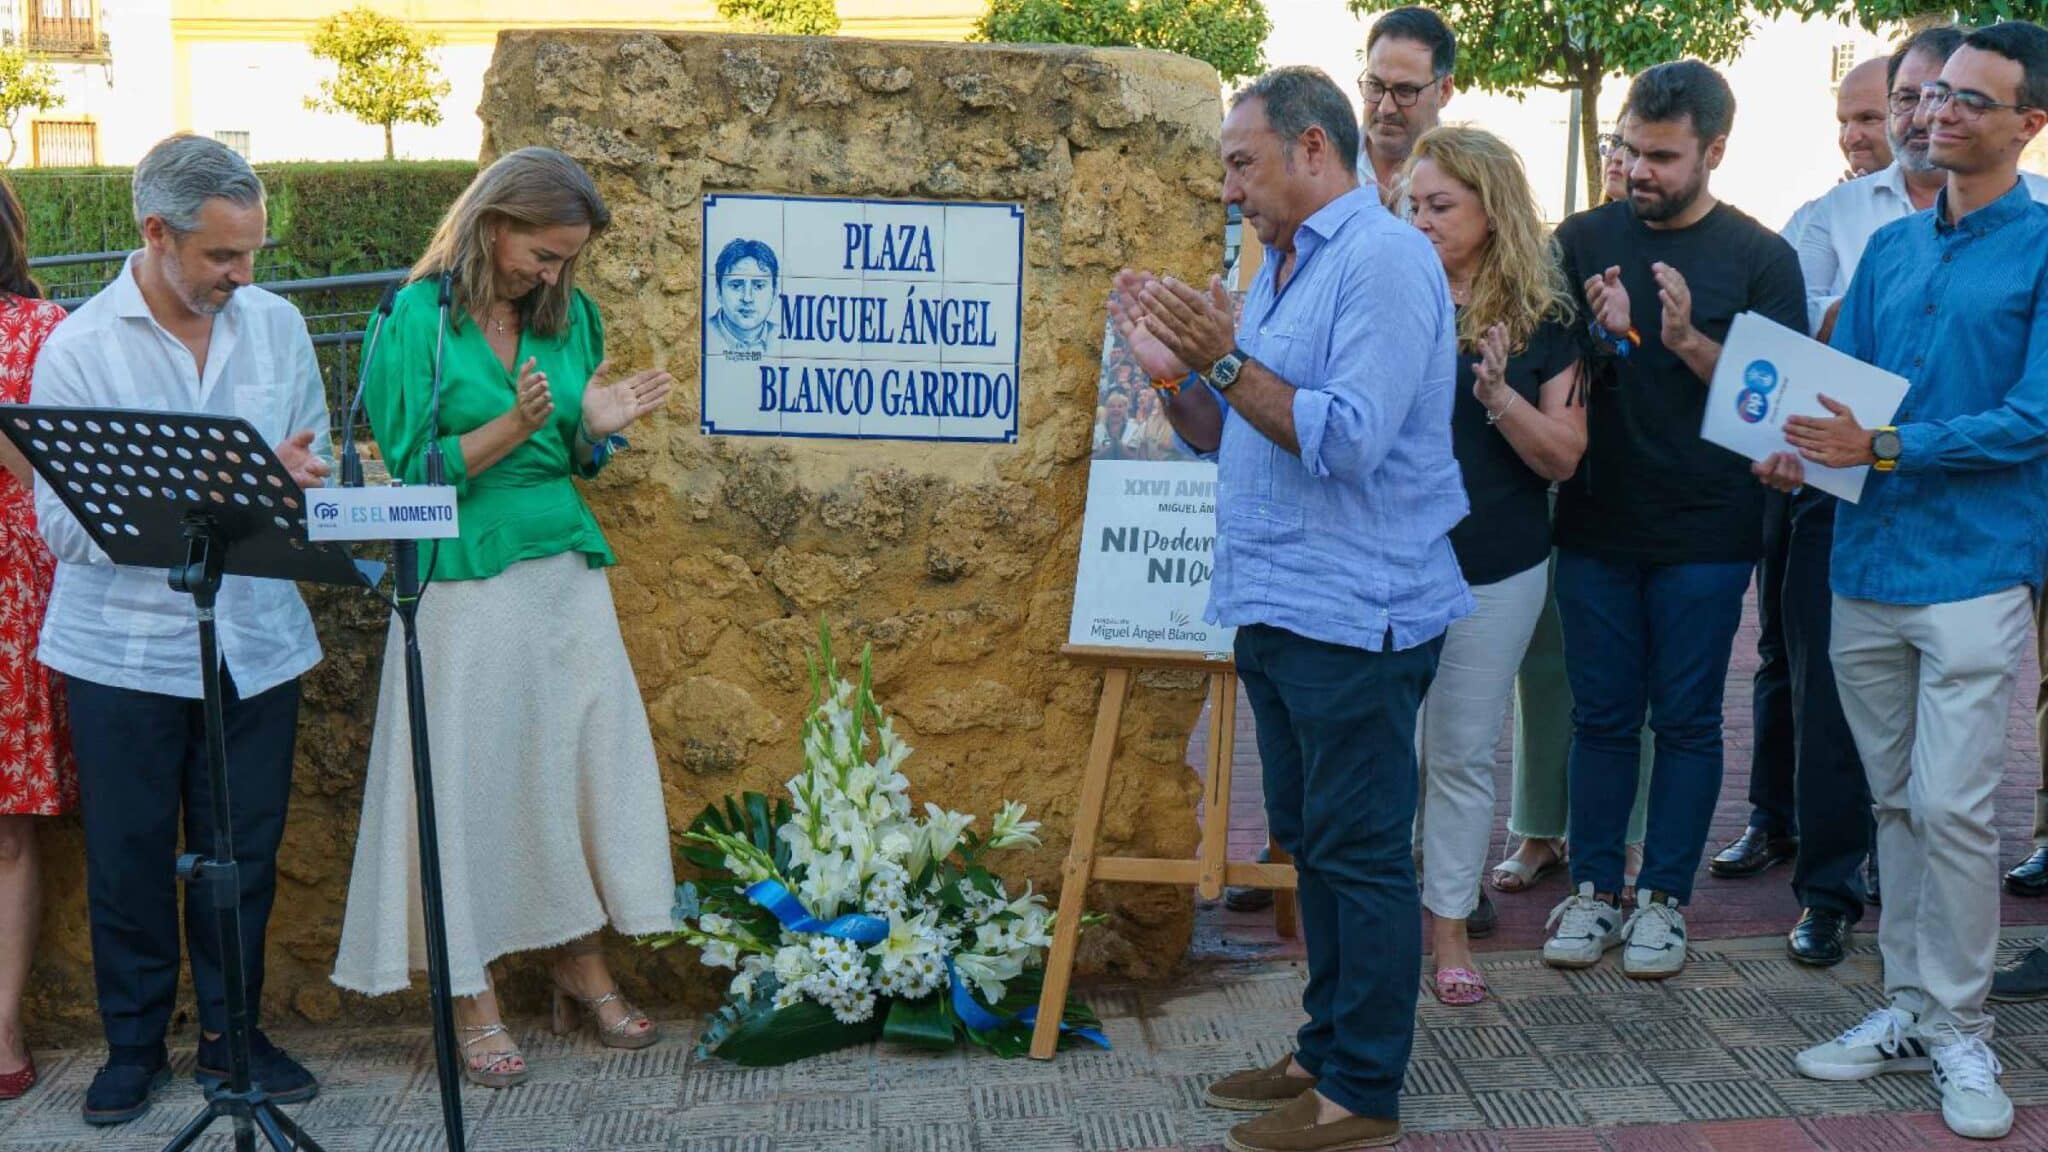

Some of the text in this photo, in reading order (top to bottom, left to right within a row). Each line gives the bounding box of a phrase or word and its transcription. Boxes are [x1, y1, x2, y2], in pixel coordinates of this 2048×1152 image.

[843, 223, 936, 272] PLAZA
[778, 285, 997, 347] MIGUEL ÁNGEL
[759, 365, 1013, 419] BLANCO GARRIDO
[1124, 479, 1170, 496] XXVI
[352, 507, 367, 523] ES
[371, 507, 385, 523] EL
[389, 505, 453, 522] MOMENTO
[1158, 502, 1217, 514] MIGUEL ÁN
[1101, 527, 1140, 553] NI
[1147, 558, 1186, 584] NI
[1091, 624, 1207, 642] Miguel Ángel Blanco
